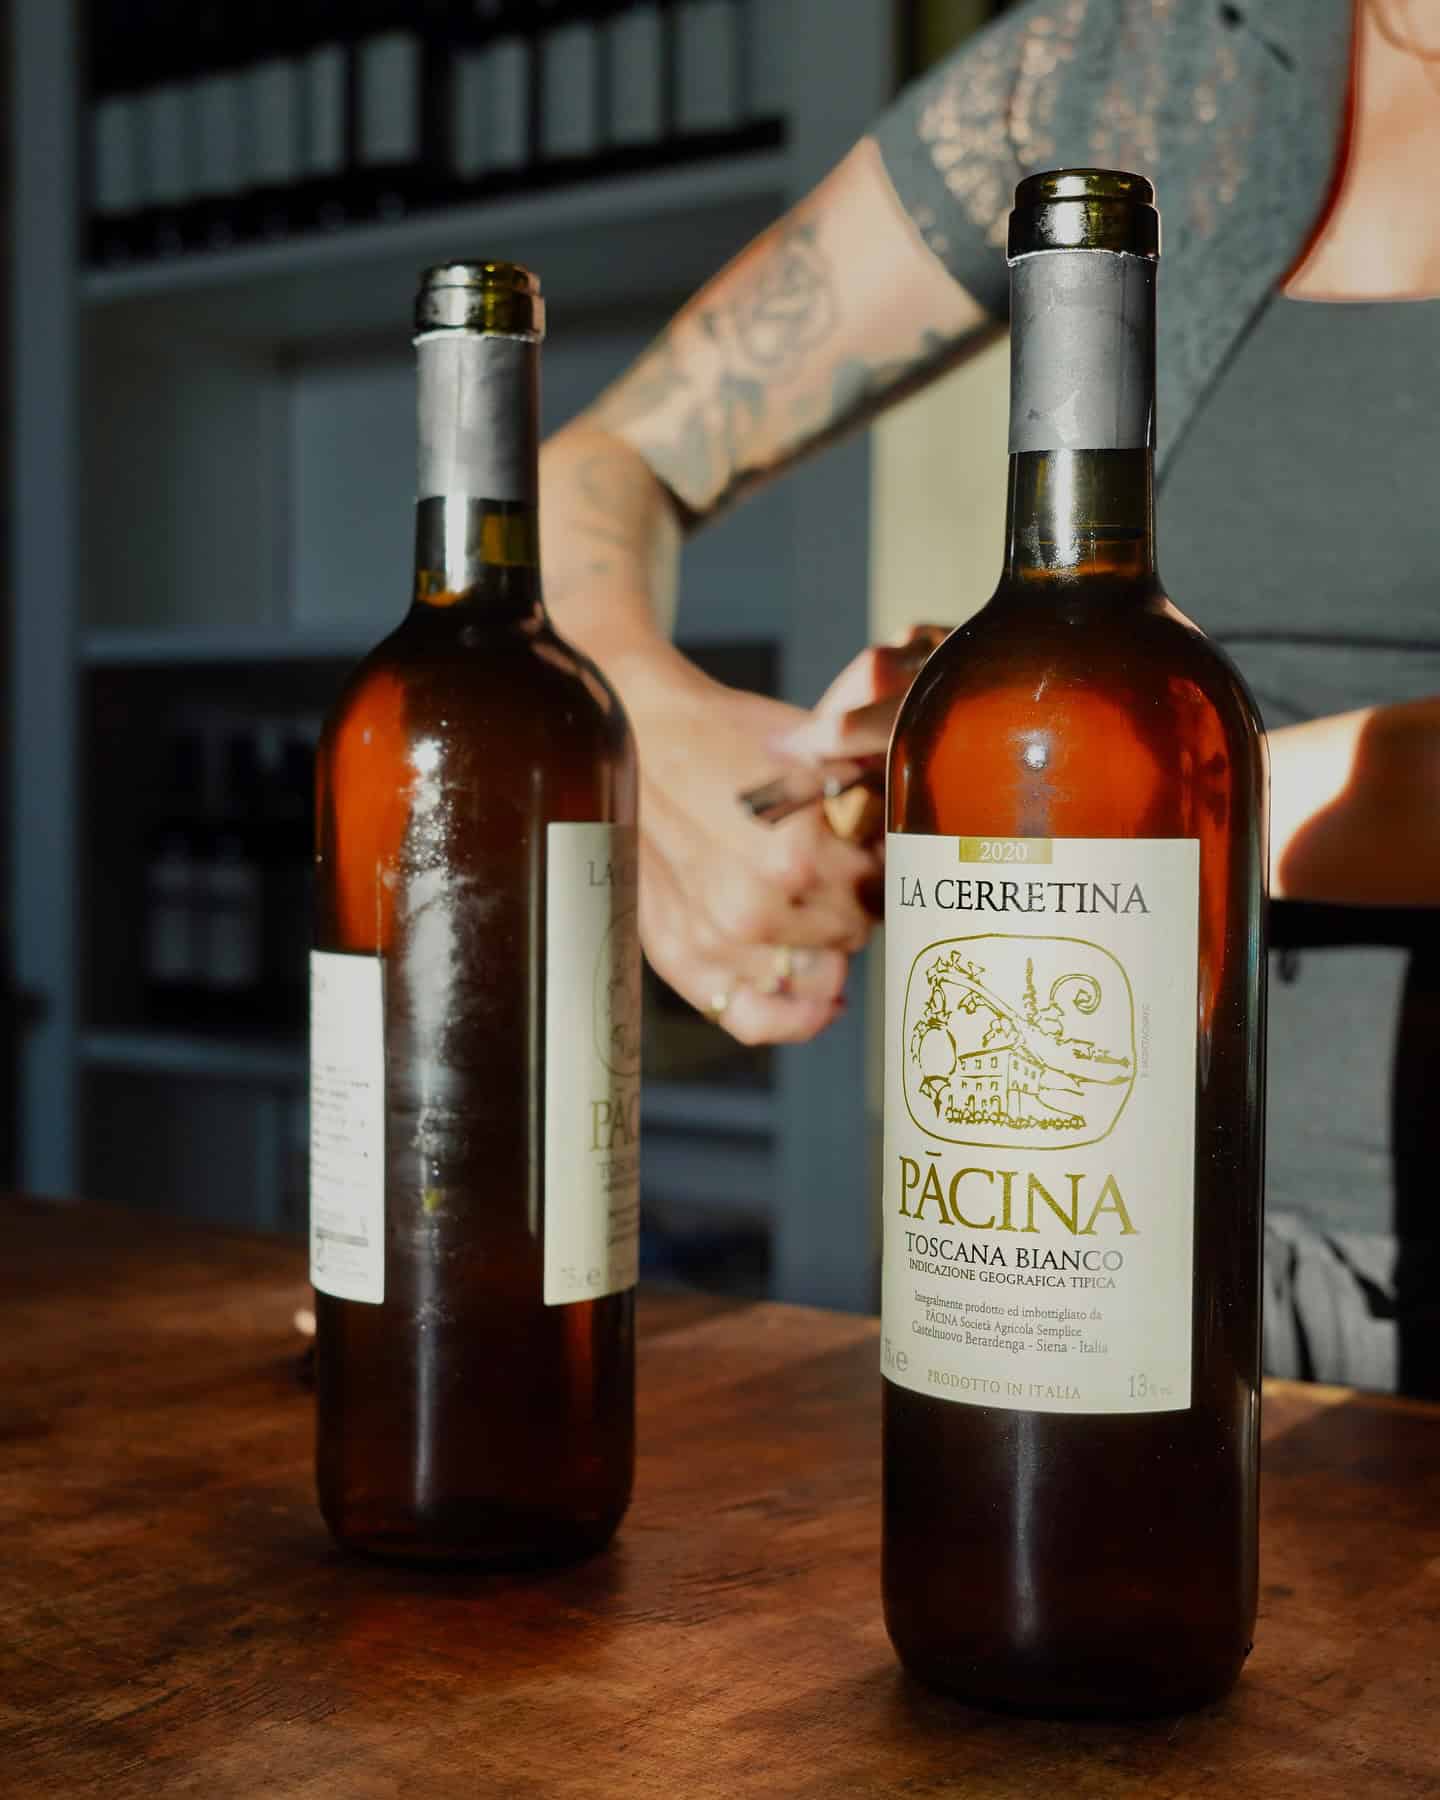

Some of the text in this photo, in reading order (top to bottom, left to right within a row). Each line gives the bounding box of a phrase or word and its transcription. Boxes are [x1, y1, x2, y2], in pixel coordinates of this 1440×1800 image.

[979, 841, 1028, 862] 2020
[900, 876, 1150, 914] LA CERRETINA
[898, 1150, 1137, 1235] PĀCINA
[905, 1231, 1123, 1272] TOSCANA BIANCO
[909, 1257, 1116, 1289] INDICAZIONE GEOGRAFICA TIPICA
[1007, 1304, 1019, 1317] ed
[965, 1331, 1025, 1354] Berardenga
[1036, 1339, 1067, 1353] Siena
[994, 1320, 1034, 1336] Agricola
[1037, 1324, 1082, 1339] Semplice
[928, 1368, 1081, 1400] PRODOTTO IN ITALIA
